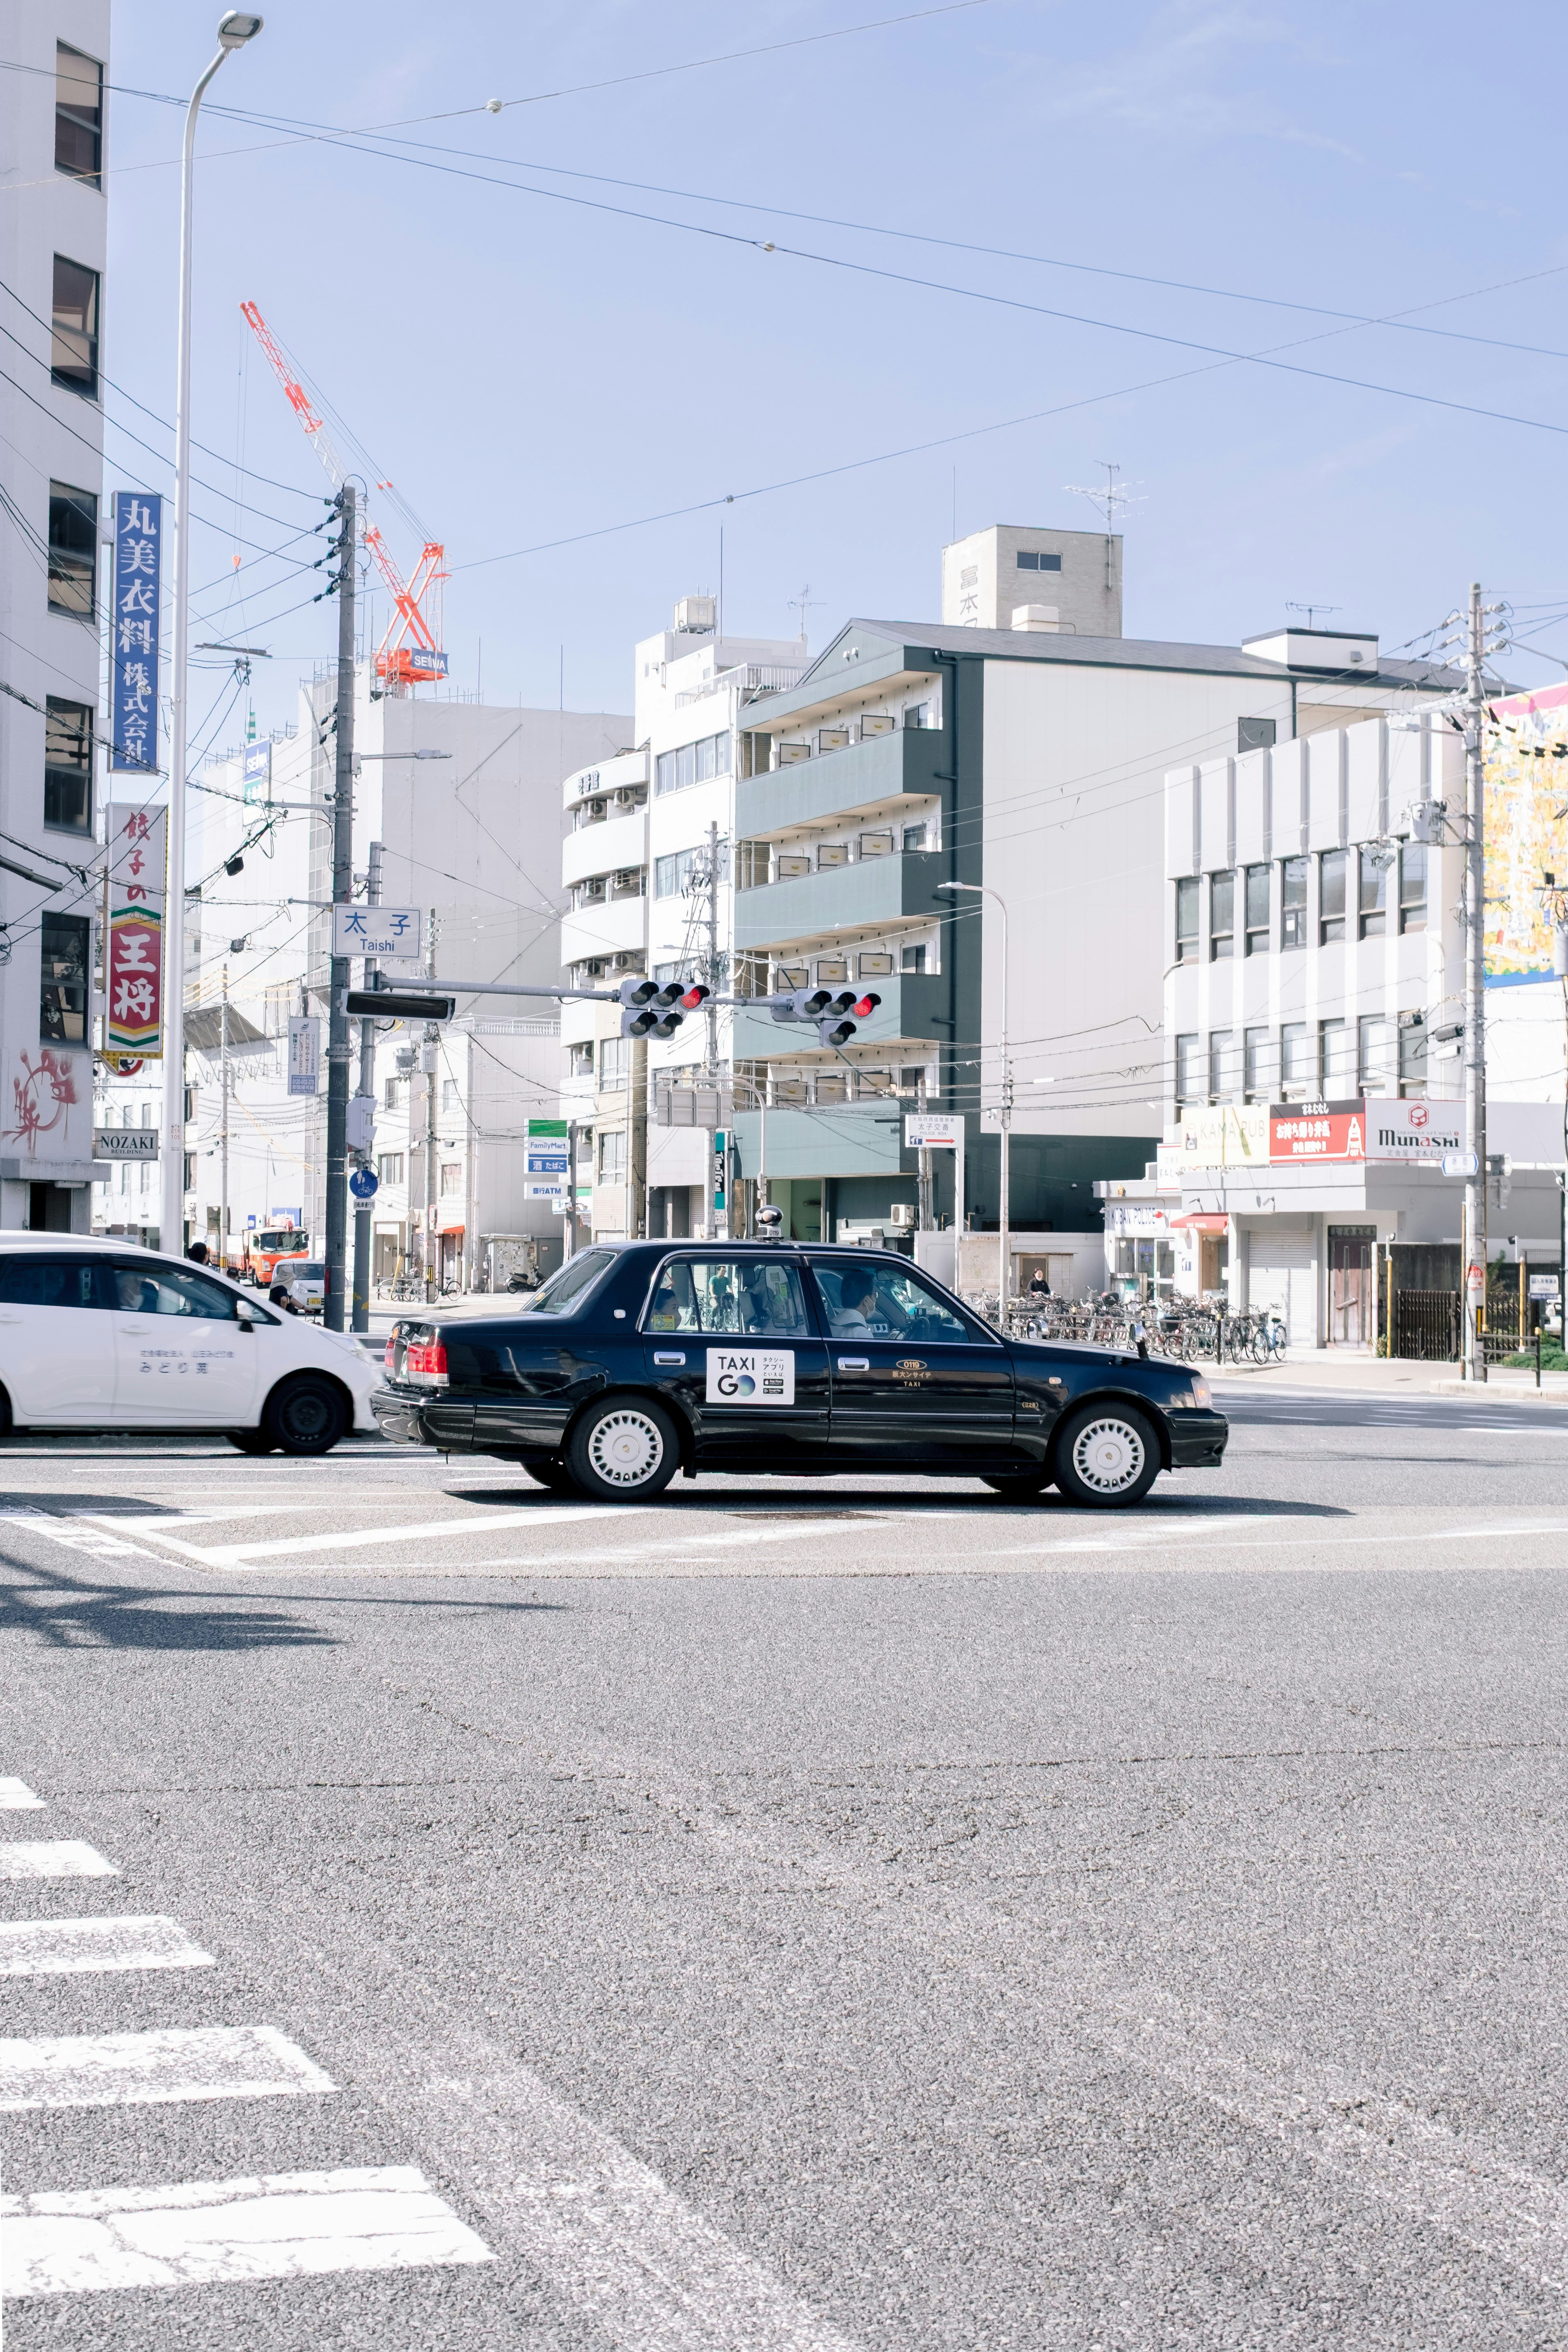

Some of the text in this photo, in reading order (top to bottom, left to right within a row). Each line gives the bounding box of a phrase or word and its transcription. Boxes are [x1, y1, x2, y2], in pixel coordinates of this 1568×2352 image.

[360, 938, 395, 952] Taishi
[114, 932, 156, 1020] 王将
[1241, 1120, 1265, 1137] PUB
[101, 1136, 154, 1149] NOZAKI
[530, 1142, 566, 1150] FamilyMart
[1414, 1149, 1448, 1158] 宮本むな
[546, 1162, 564, 1170] たばこ
[718, 1356, 755, 1371] TAXI
